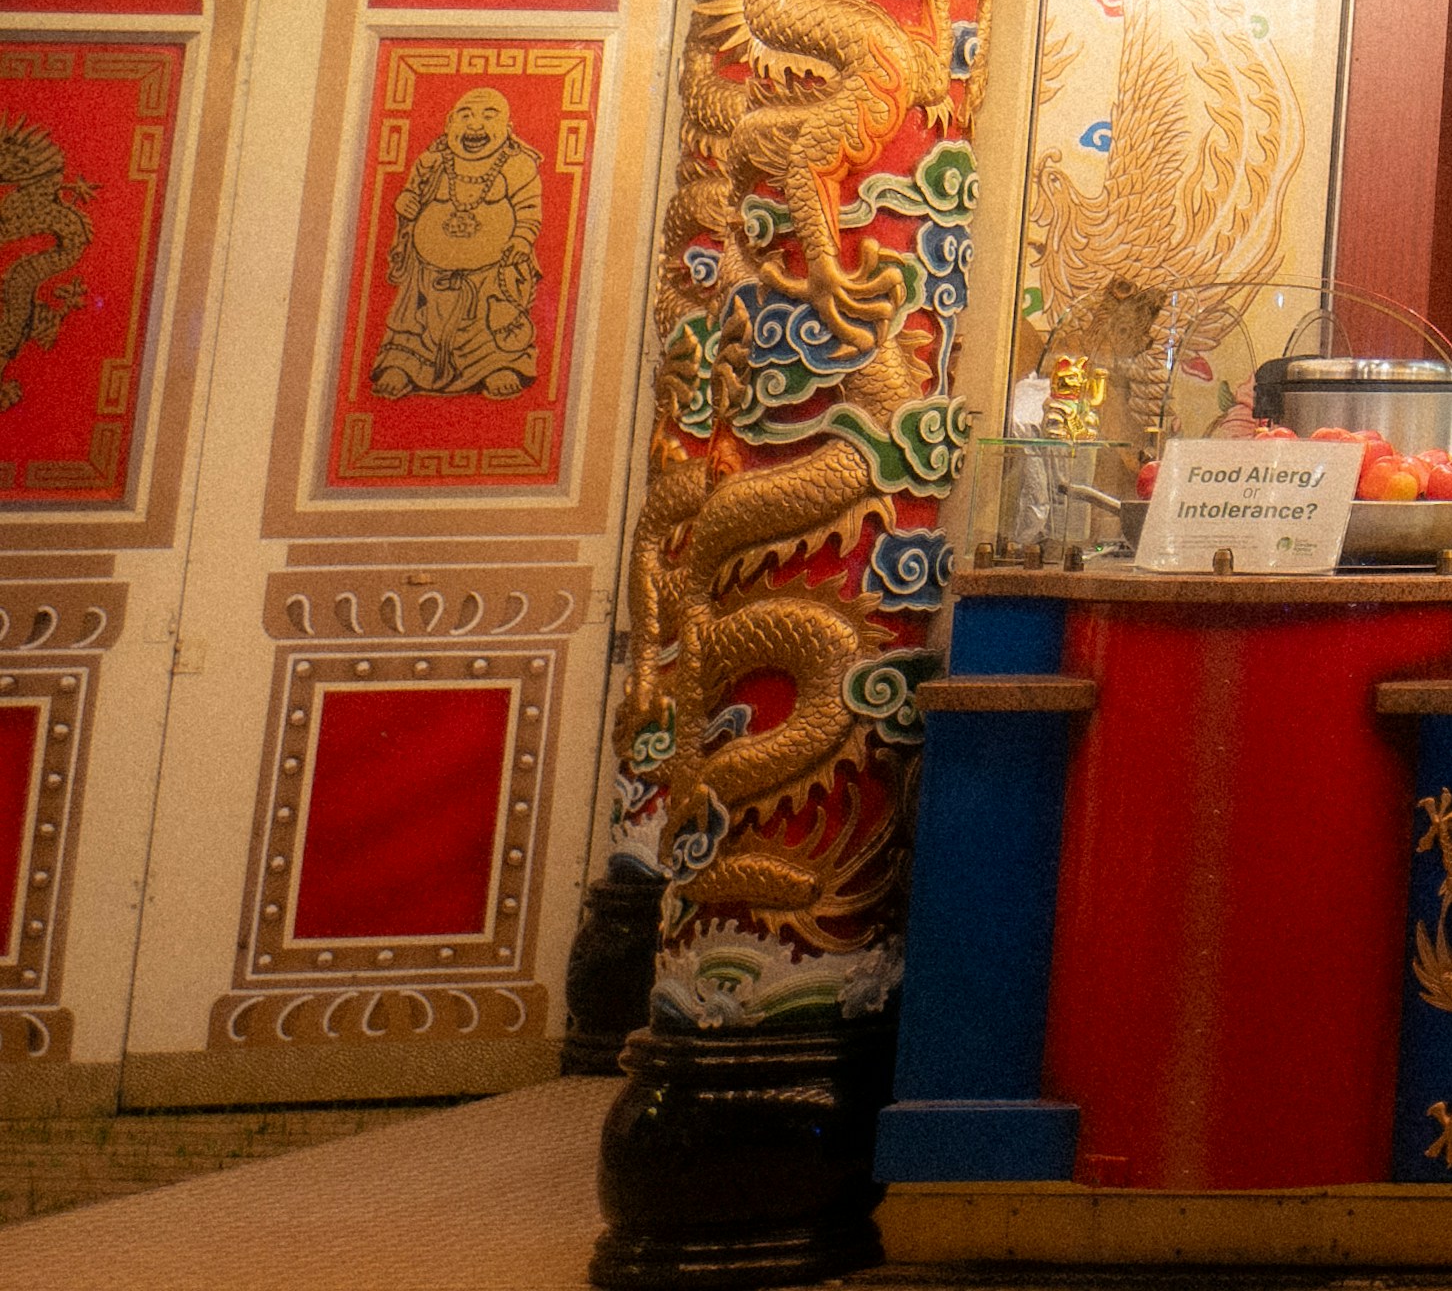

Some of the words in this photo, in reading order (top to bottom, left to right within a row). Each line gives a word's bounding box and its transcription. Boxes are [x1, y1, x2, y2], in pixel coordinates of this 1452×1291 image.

[1187, 466, 1241, 483] Food
[1245, 467, 1326, 488] Allergy
[1242, 487, 1261, 500] or
[1177, 501, 1319, 520] Intolerance?
